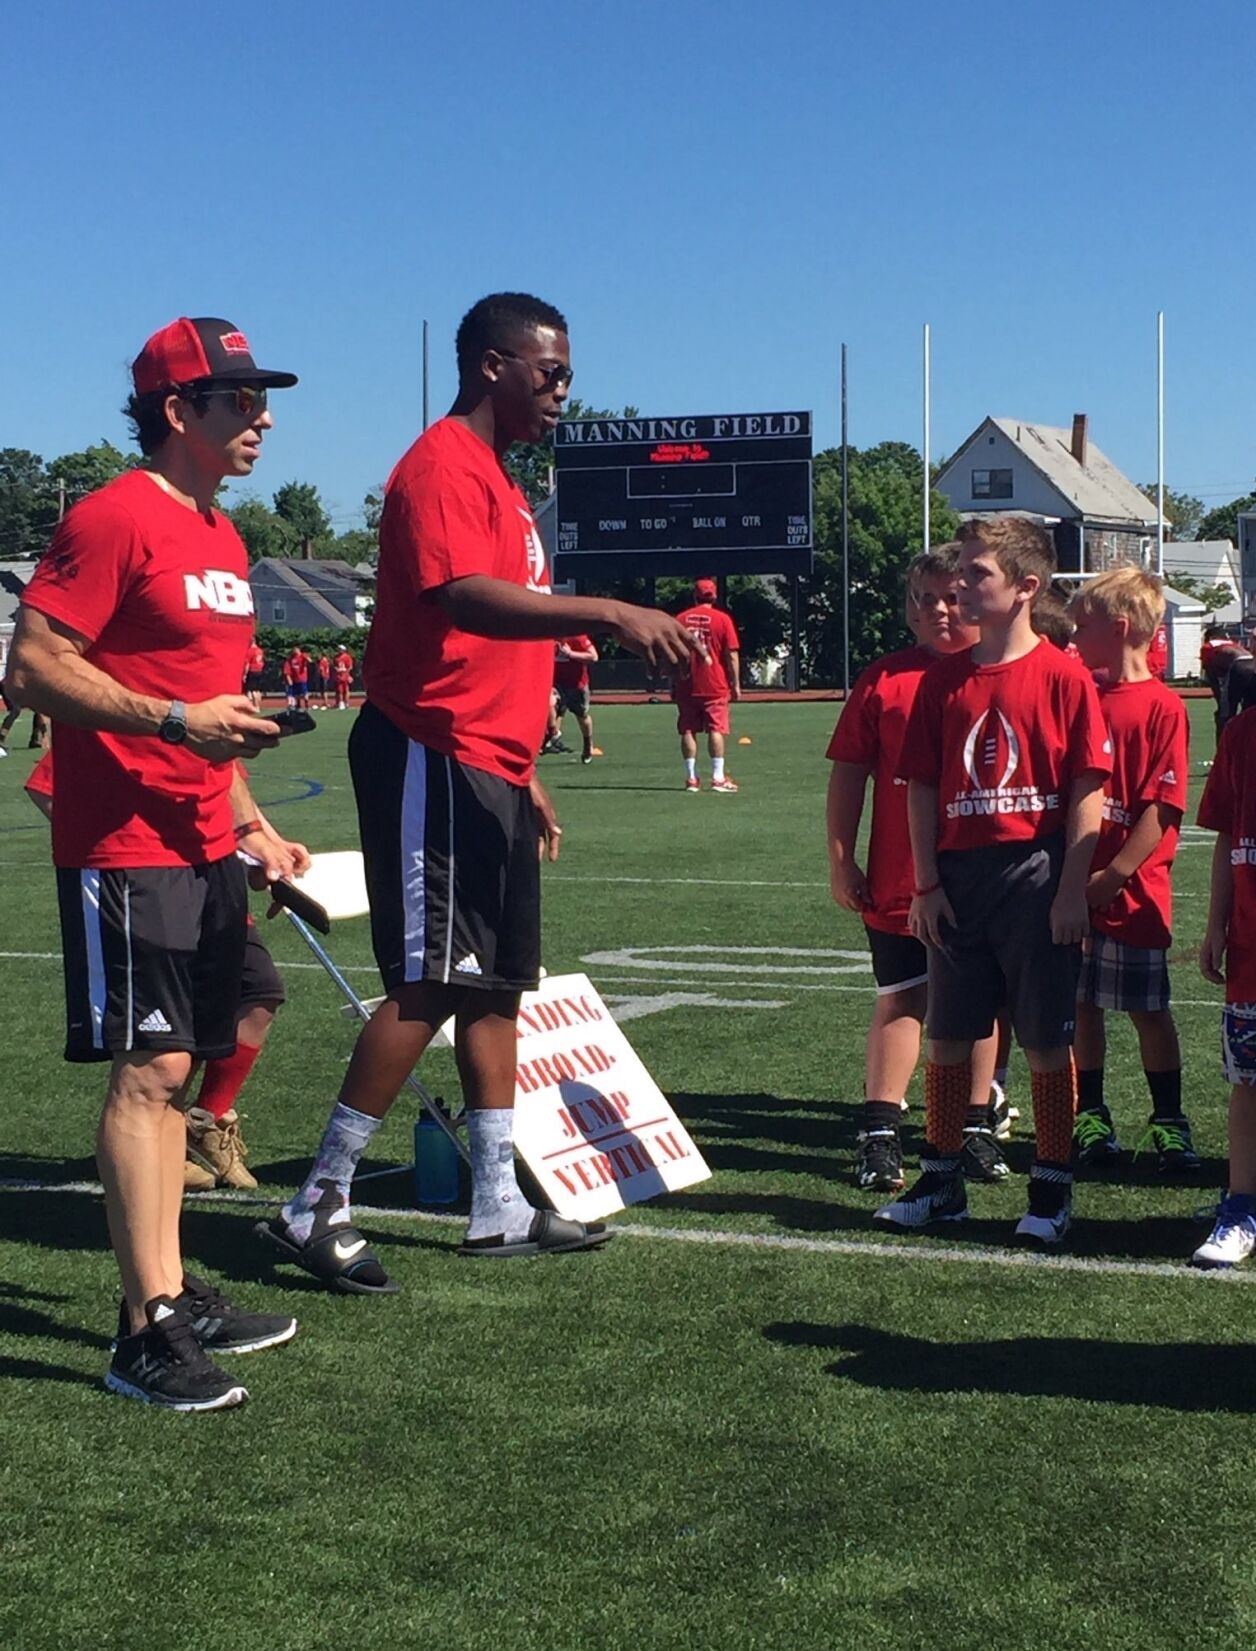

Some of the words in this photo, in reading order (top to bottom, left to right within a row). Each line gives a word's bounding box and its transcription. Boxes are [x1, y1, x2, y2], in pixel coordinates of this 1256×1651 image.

[564, 420, 697, 443] MANNING
[713, 415, 801, 437] FIELD
[599, 520, 627, 531] DOWN
[640, 519, 652, 530] TO
[654, 518, 667, 529] GO
[692, 517, 712, 528] BALL
[714, 516, 726, 527] ON
[742, 515, 760, 527] QTR
[560, 541, 578, 550] LEFT
[516, 994, 603, 1038] NDING
[557, 1090, 631, 1138] JUMP
[552, 1131, 691, 1196] VERTICAL
